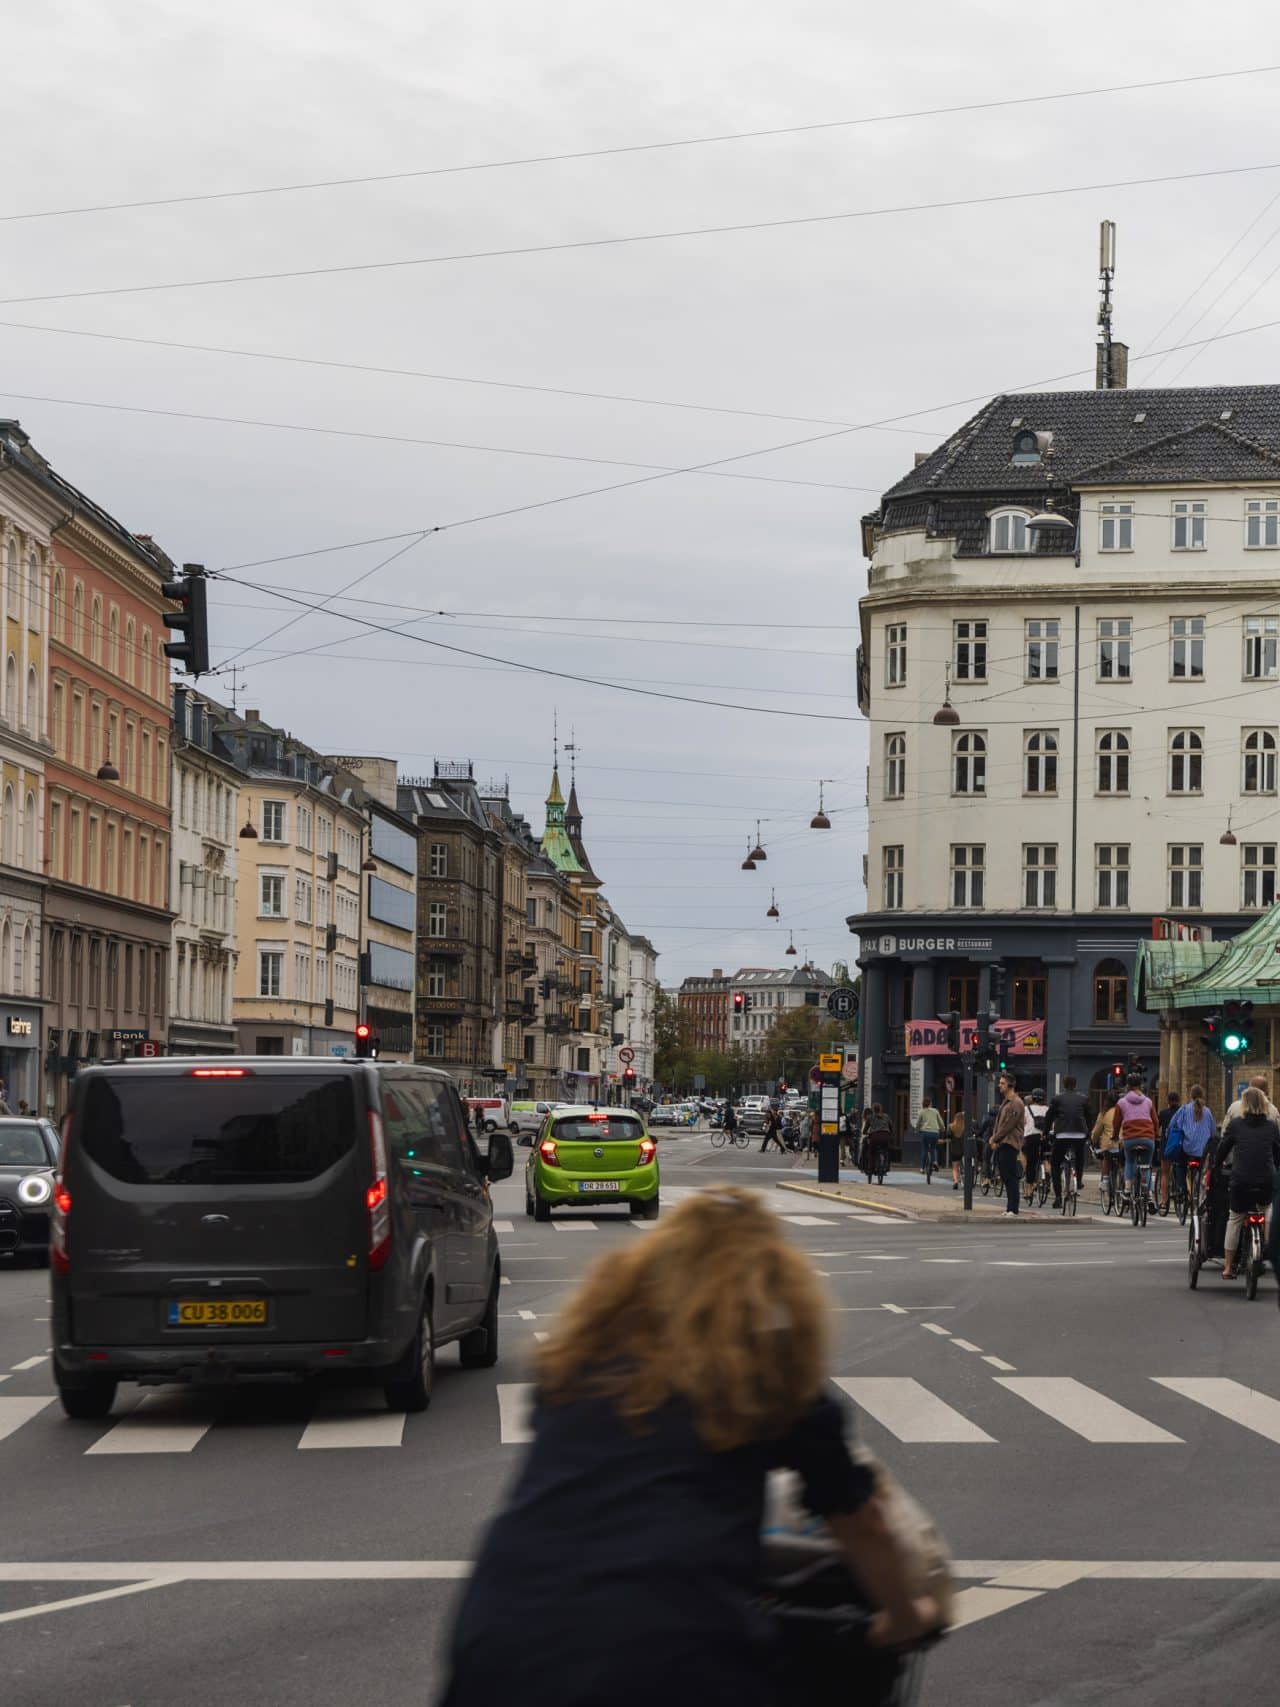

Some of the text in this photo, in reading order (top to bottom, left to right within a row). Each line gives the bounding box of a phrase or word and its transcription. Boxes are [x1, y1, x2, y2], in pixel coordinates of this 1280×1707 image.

[899, 938, 955, 950] BURGER
[957, 940, 993, 948] RESTAURANT
[113, 1031, 145, 1040] Bank
[143, 1042, 156, 1057] B
[182, 1303, 263, 1320] CU 38 006
